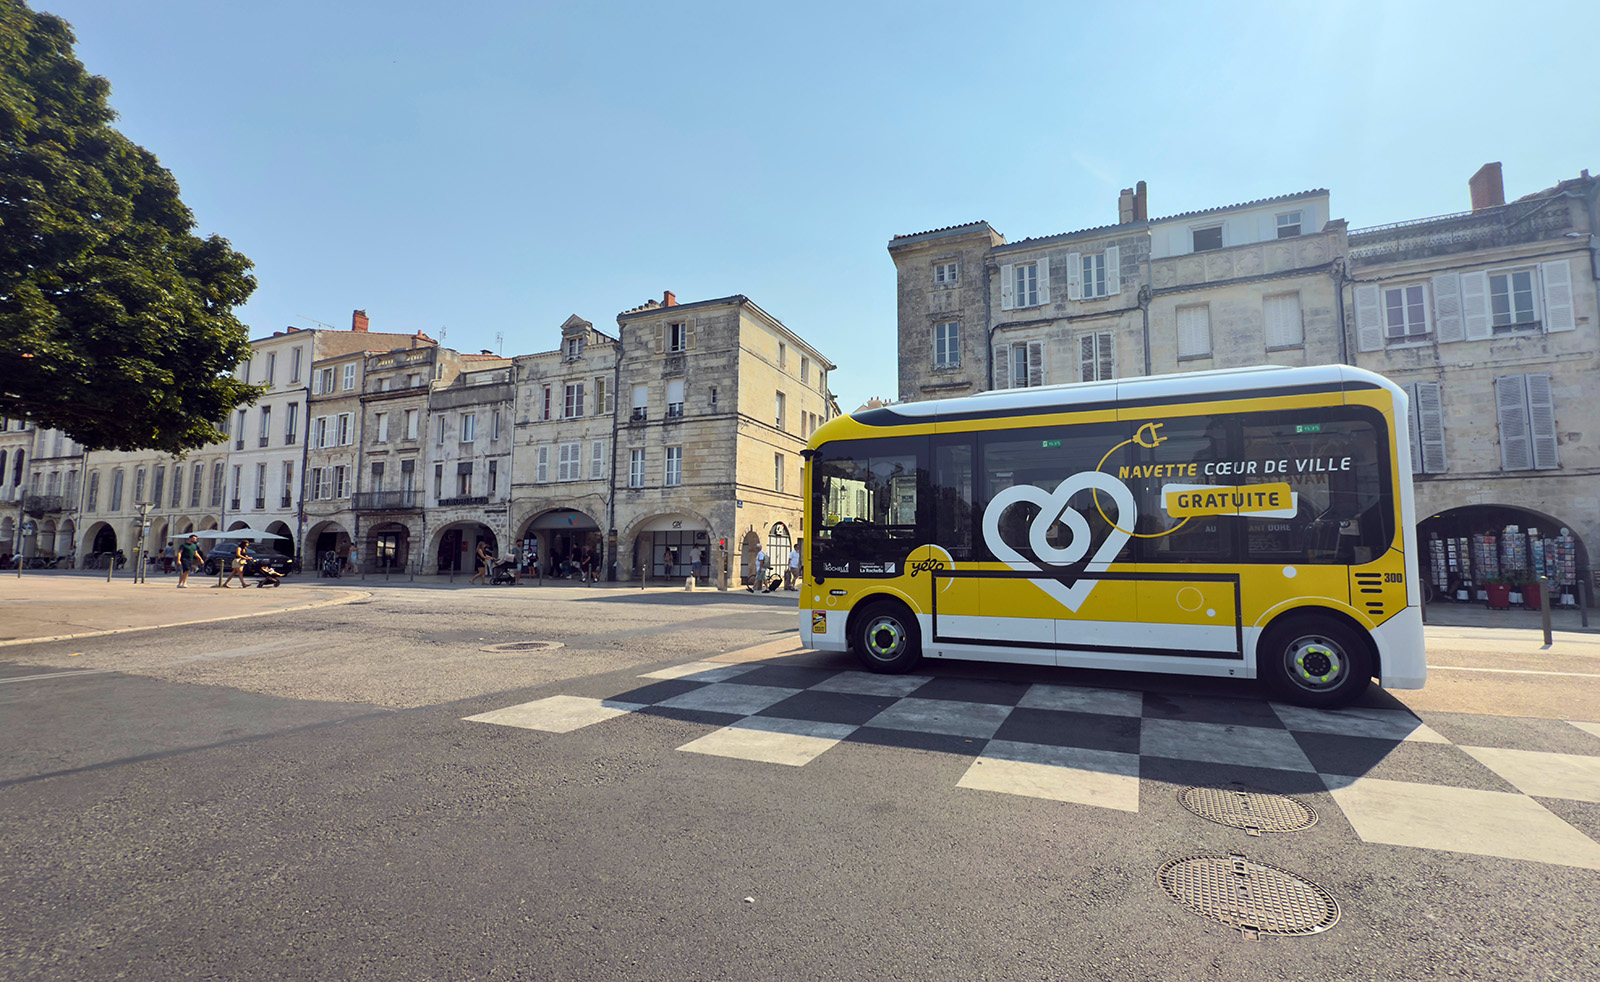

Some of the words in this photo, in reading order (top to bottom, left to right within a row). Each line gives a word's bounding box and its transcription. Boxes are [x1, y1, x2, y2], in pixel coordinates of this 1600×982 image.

[1118, 462, 1198, 479] NAVETTE
[1204, 460, 1257, 476] CŒUR
[1264, 459, 1288, 474] DE
[1296, 456, 1352, 472] VILLE
[1177, 491, 1280, 509] GRATUITE
[911, 558, 944, 577] yélo
[1384, 572, 1403, 583] 300
